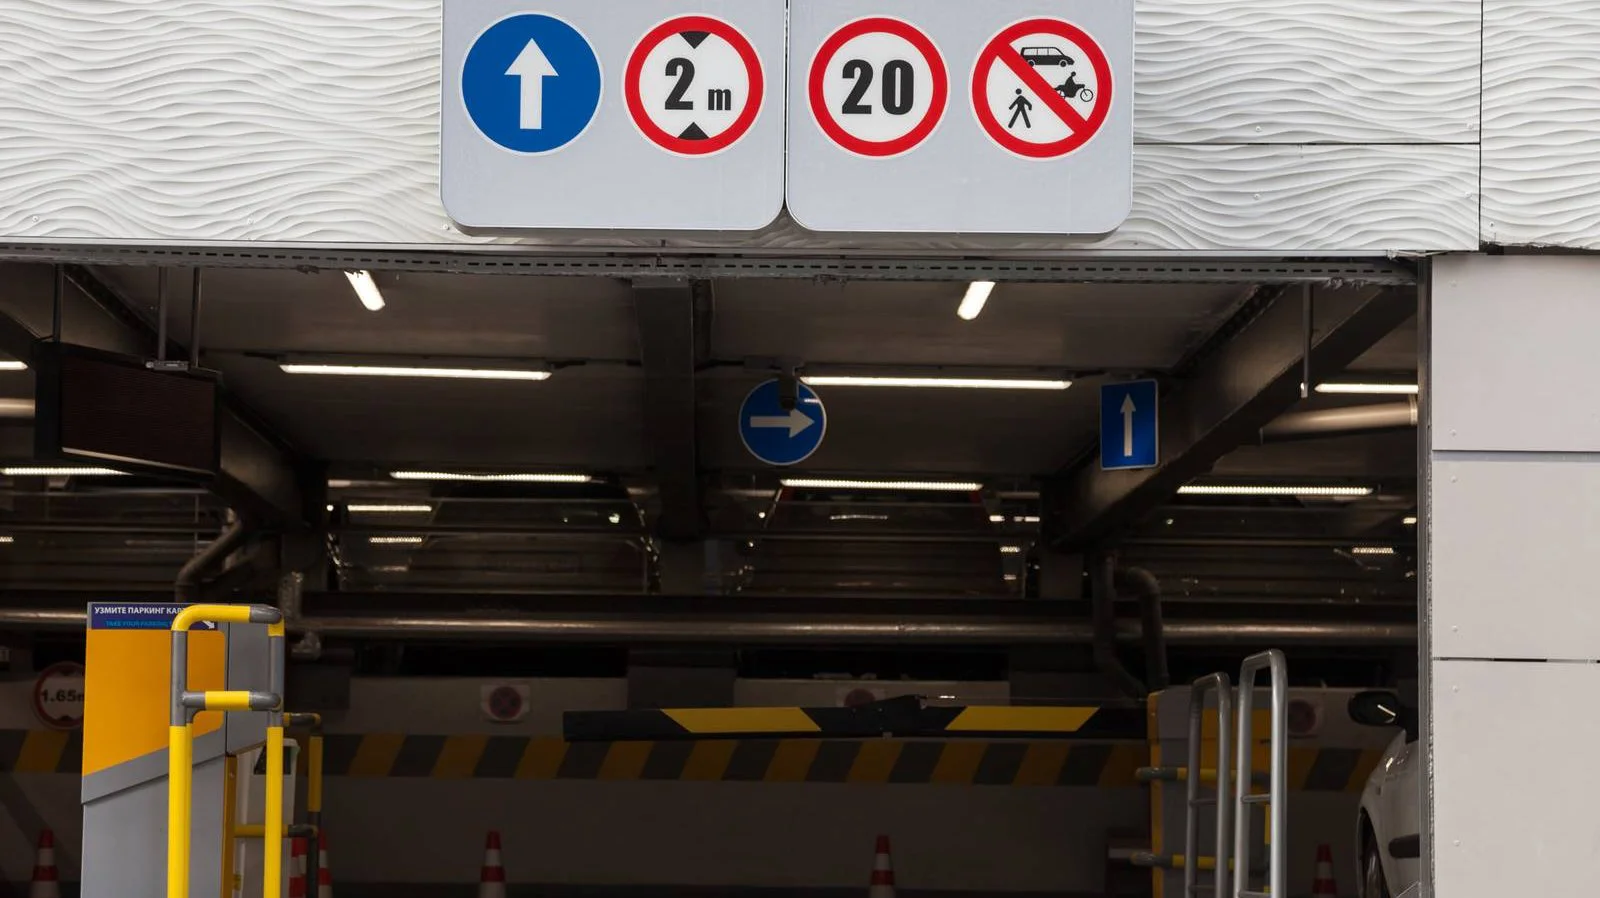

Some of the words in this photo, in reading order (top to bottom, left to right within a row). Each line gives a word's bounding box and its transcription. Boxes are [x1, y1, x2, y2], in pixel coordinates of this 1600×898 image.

[664, 57, 695, 111] 2
[707, 88, 732, 111] m
[841, 58, 914, 115] 20
[94, 606, 127, 614] УЗМИТЕ
[128, 606, 165, 614] ПАРКИНГ
